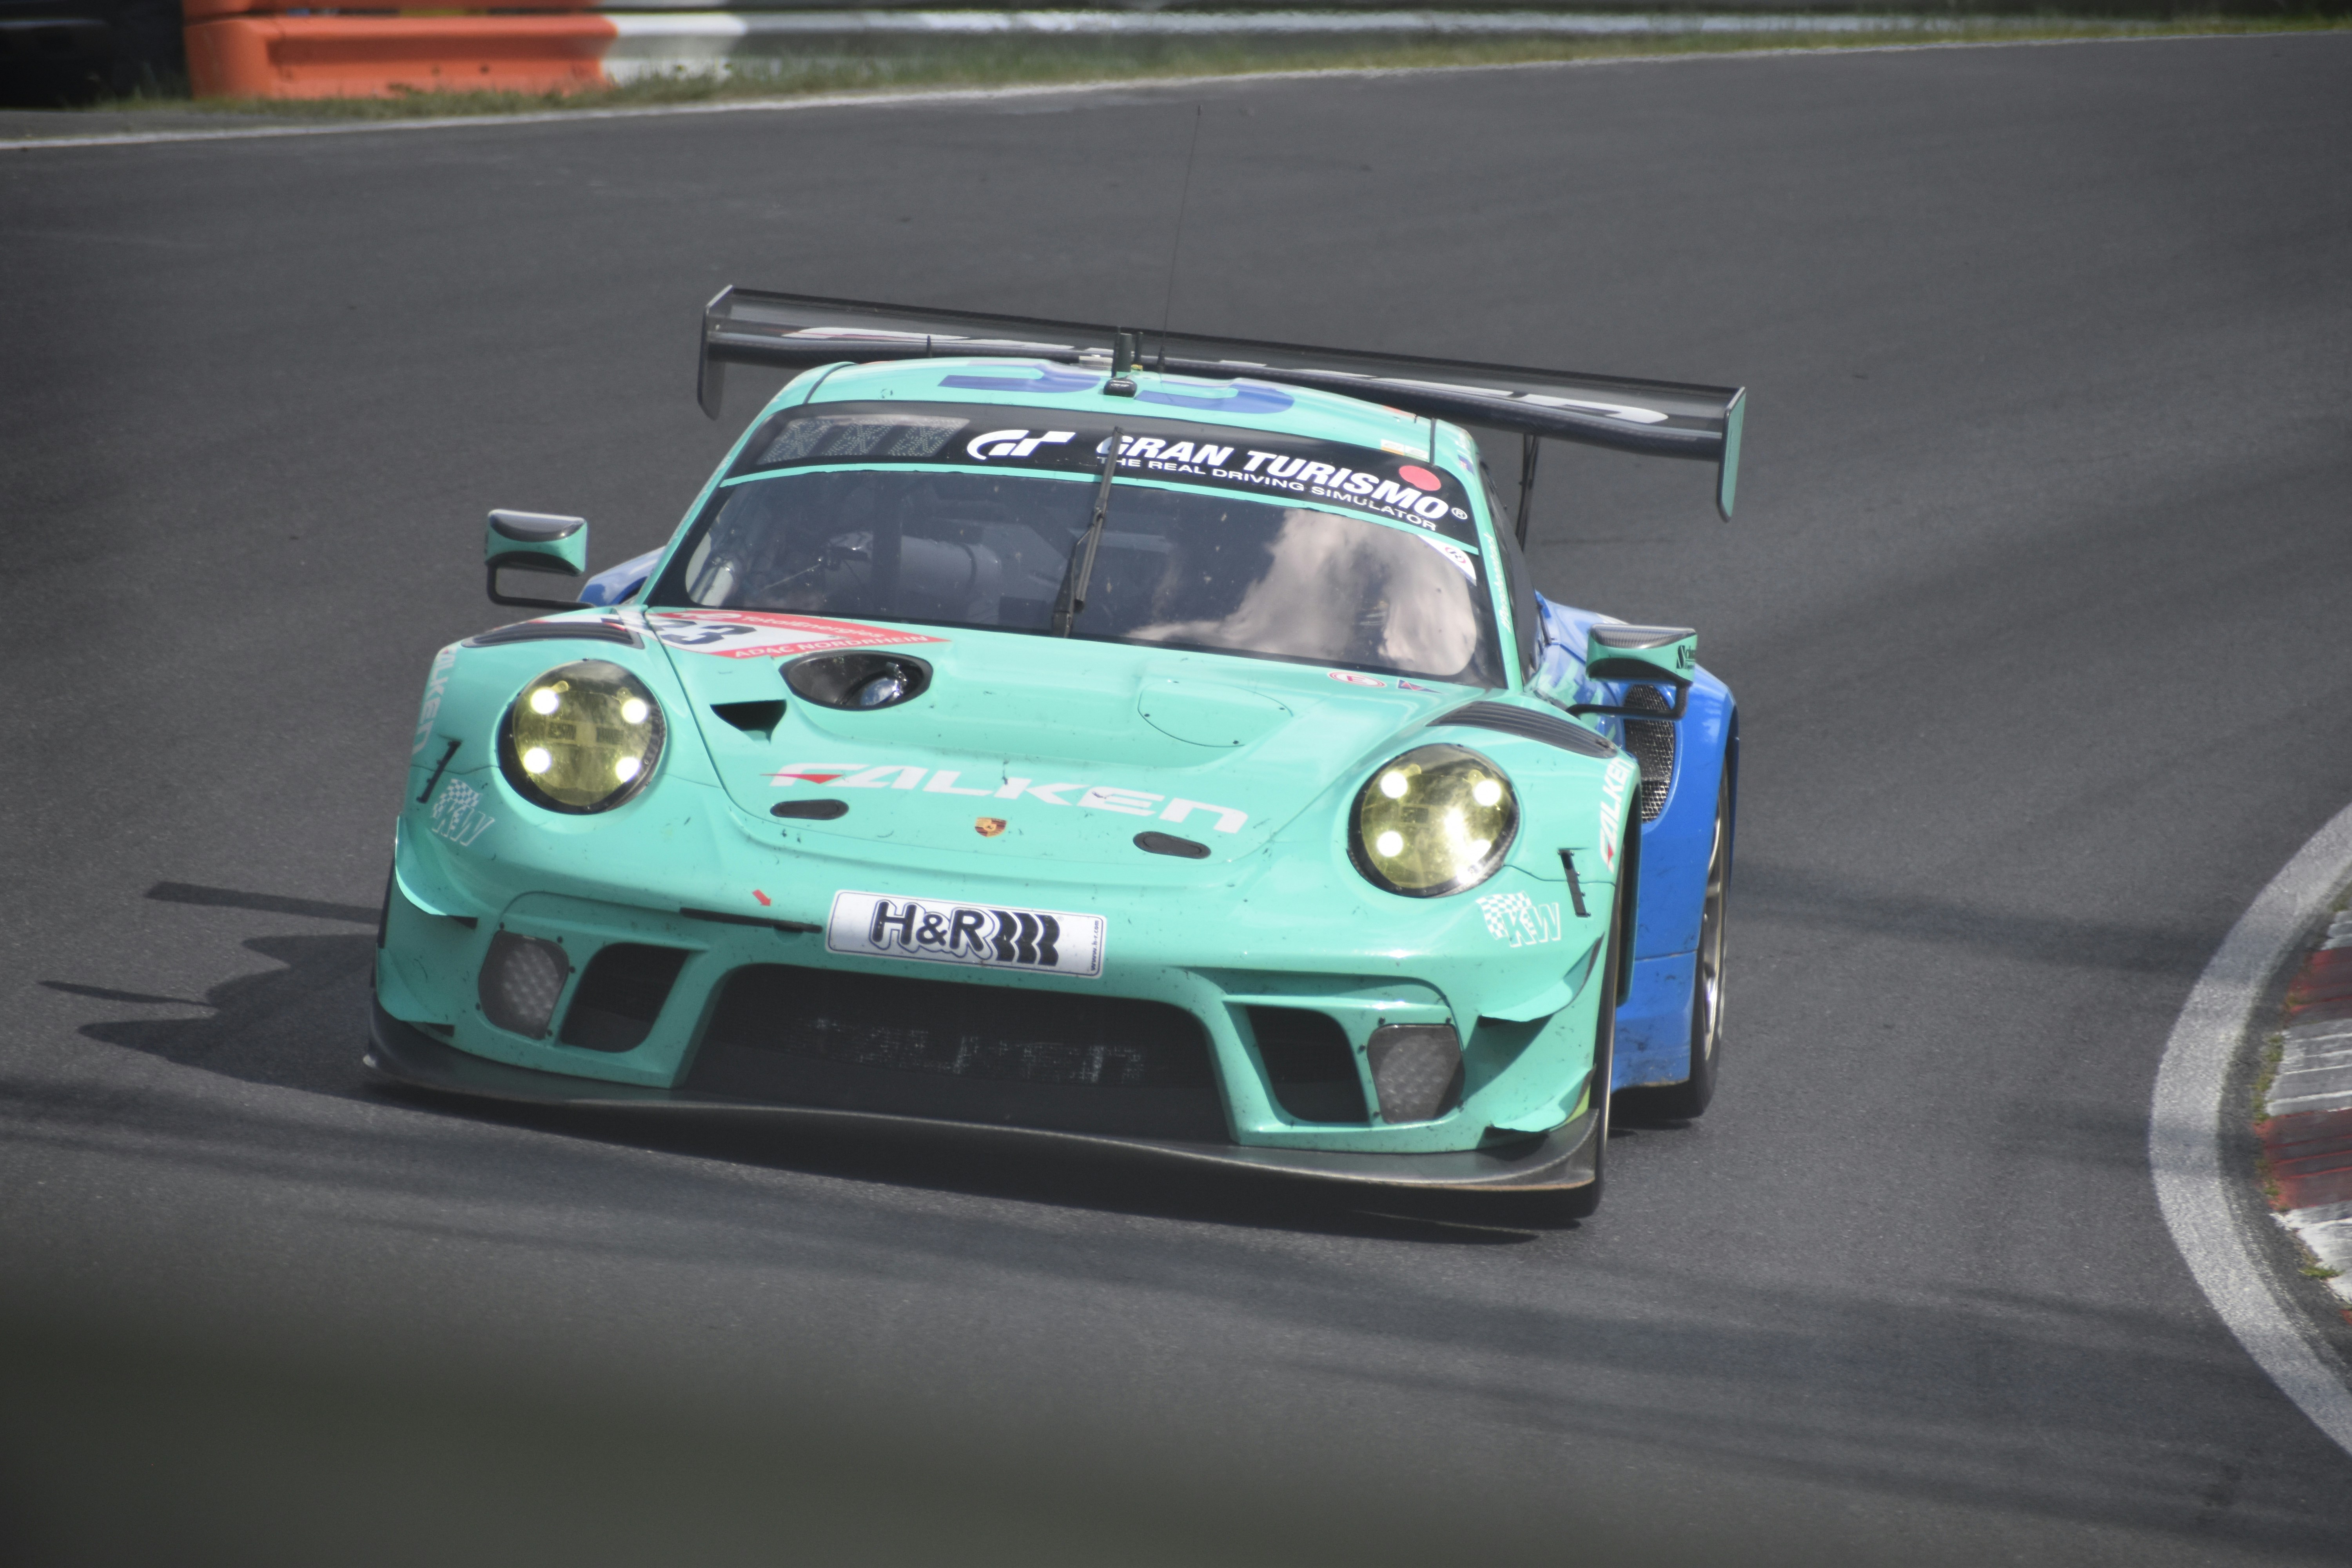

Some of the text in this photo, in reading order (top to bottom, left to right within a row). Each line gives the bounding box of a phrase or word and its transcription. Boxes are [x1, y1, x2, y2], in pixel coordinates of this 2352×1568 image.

[1096, 436, 1234, 465] GRAN
[1243, 450, 1449, 519] TURISMO
[1097, 457, 1436, 531] THE REAL DRIVING SIMULATOR
[735, 635, 928, 659] ADAC NORDRHEIN
[742, 616, 885, 638] TotalEnergies
[760, 763, 1249, 834] FALKEN
[1600, 758, 1635, 873] FALKEN
[871, 900, 994, 958] H&R
[1091, 920, 1099, 971] www.h-r.com
[1500, 903, 1561, 948] KW
